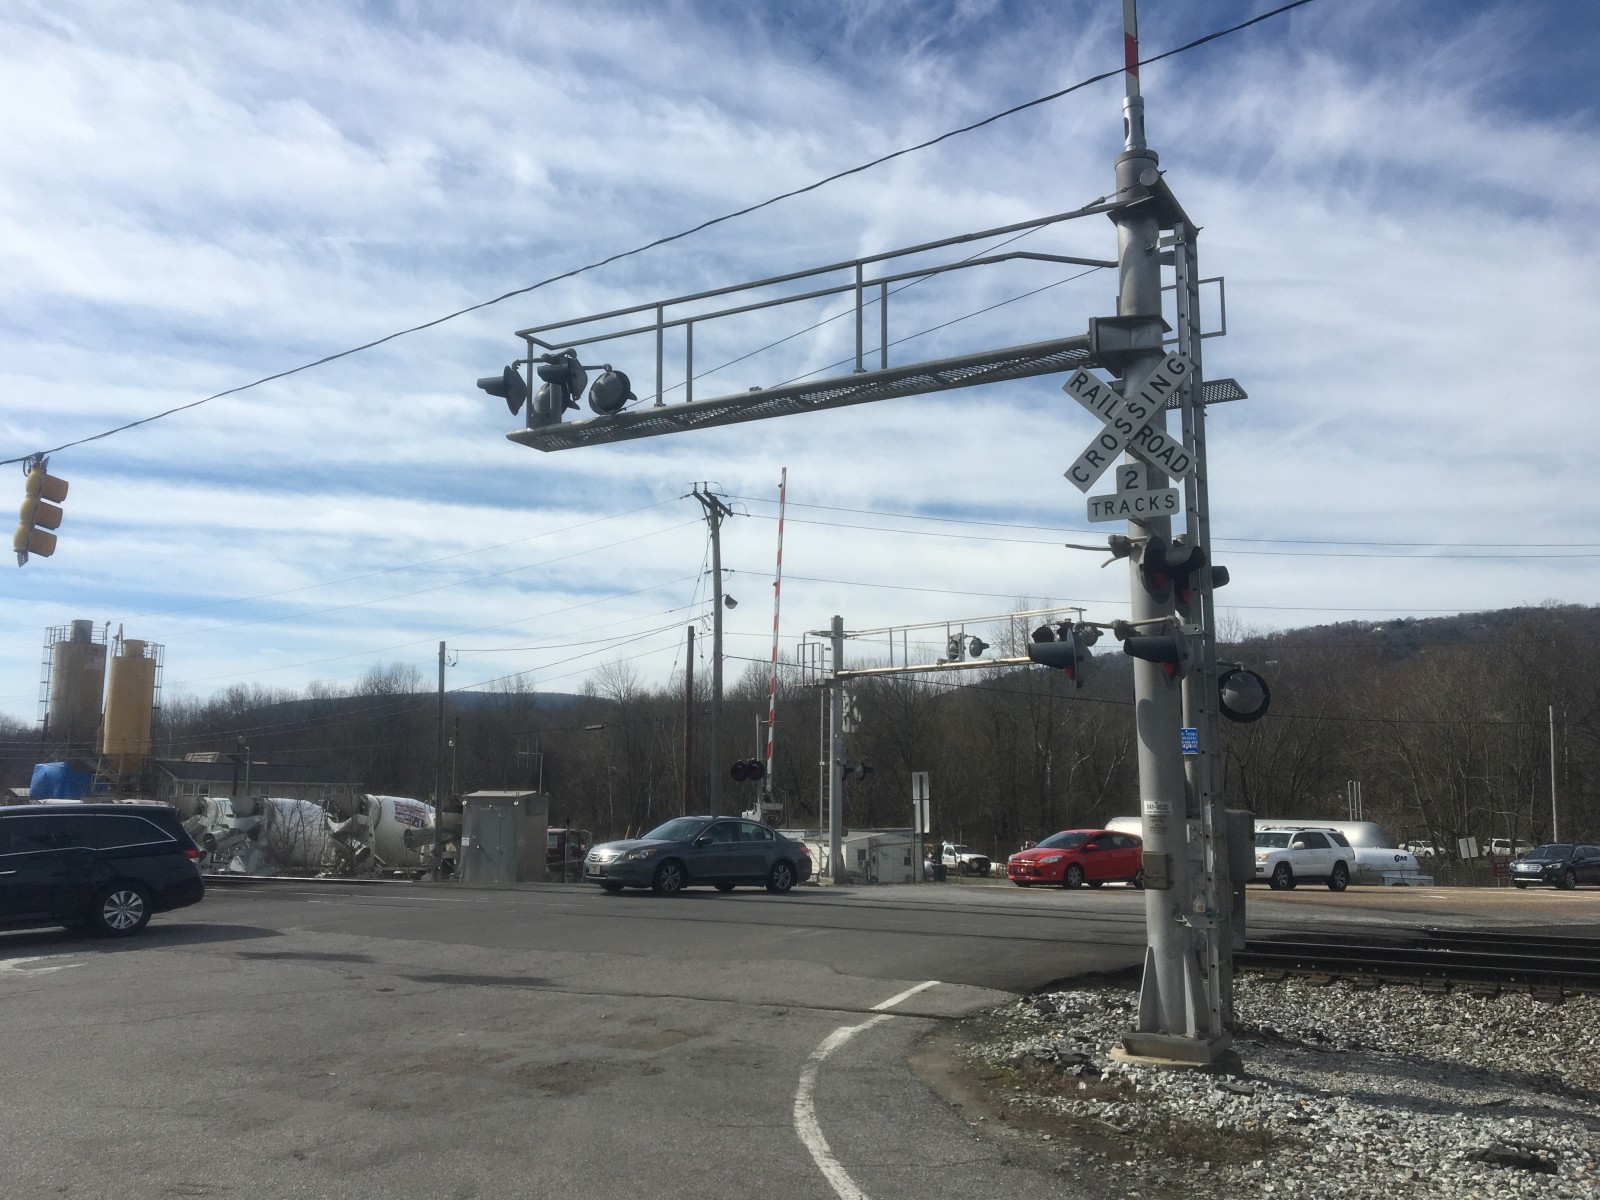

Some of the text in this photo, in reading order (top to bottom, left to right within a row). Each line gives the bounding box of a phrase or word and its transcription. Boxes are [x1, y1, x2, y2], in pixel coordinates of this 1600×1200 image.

[1071, 357, 1186, 483] CROSSING
[1124, 470, 1139, 490] 2
[1091, 494, 1175, 517] TRACKS
